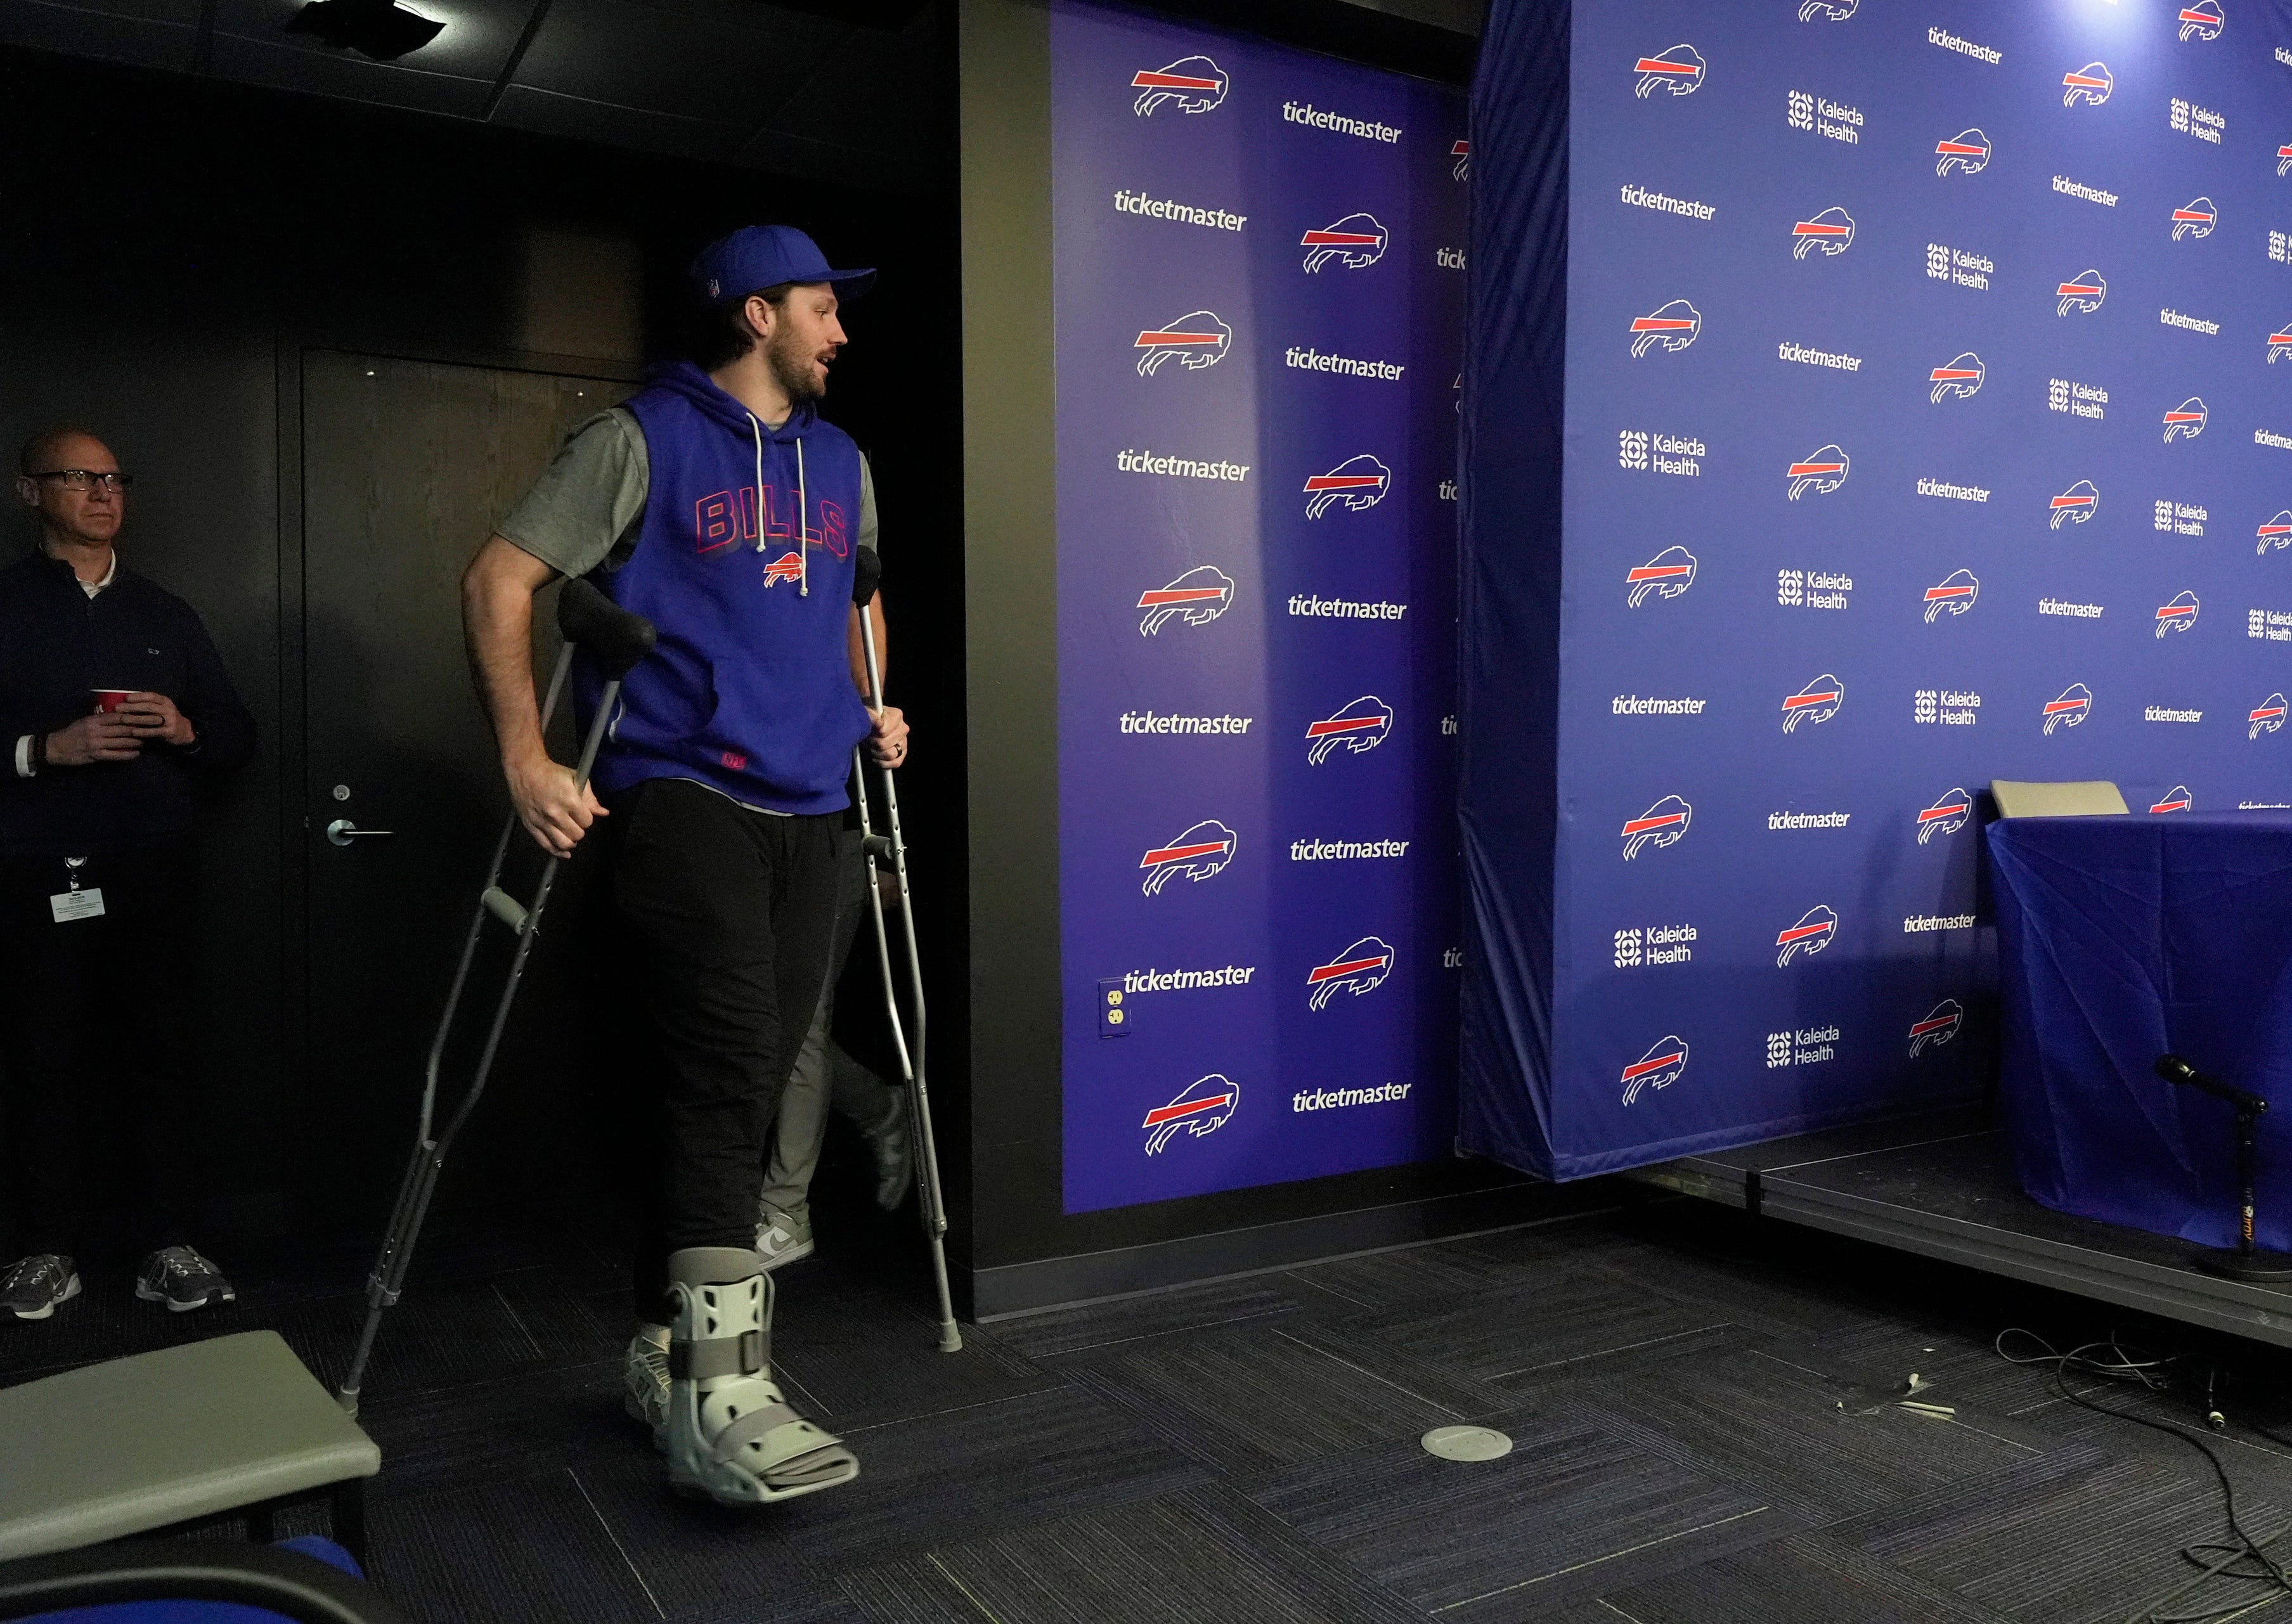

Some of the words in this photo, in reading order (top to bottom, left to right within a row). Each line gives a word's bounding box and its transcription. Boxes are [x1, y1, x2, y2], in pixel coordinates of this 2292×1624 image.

[1929, 27, 2002, 64] ticketmaster
[1283, 101, 1402, 143] ticketmaster
[1818, 98, 1863, 126] Kaleida
[2192, 105, 2224, 129] Kaleida
[1818, 118, 1858, 144] Health
[2191, 122, 2220, 144] Health
[1621, 184, 1715, 220] ticketmaster
[2053, 176, 2118, 207] ticketmaster
[1115, 190, 1246, 231] ticketmaster
[1953, 249, 1993, 273] Kaleida
[1953, 268, 1988, 290] Health
[2161, 309, 2219, 335] ticketmaster
[1286, 347, 1404, 380] ticketmaster
[1779, 342, 1861, 371] ticketmaster
[2073, 382, 2107, 403] Kaleida
[2072, 401, 2103, 419] Health
[1654, 434, 1705, 456] Kaleida
[2255, 429, 2292, 449] ticketma
[1118, 449, 1250, 481] ticketmaster
[1654, 454, 1699, 476] Health
[1917, 478, 1990, 502] ticketmaster
[696, 485, 848, 557] BILLS
[2175, 503, 2207, 520] Kaleida
[2175, 520, 2203, 536] Health
[1808, 572, 1852, 590] Kaleida
[1288, 595, 1406, 619] ticketmaster
[1807, 592, 1846, 609] Health
[2039, 598, 2103, 617] ticketmaster
[2266, 626, 2291, 641] Health
[1612, 695, 1706, 714] ticketmaster
[1941, 691, 1980, 707] Kaleida
[1120, 711, 1252, 733] ticketmaster
[1940, 709, 1975, 725] Health
[2145, 706, 2202, 722] ticketmaster
[1768, 811, 1850, 829] ticketmaster
[1291, 839, 1409, 860] ticketmaster
[1647, 924, 1696, 943] Kaleida
[1904, 914, 1975, 932] ticketmaster
[1647, 944, 1690, 965] Health
[1124, 965, 1255, 993] ticketmaster
[1796, 1026, 1839, 1045] Kaleida
[1795, 1045, 1833, 1065] Health
[1293, 1083, 1411, 1112] ticketmaster
